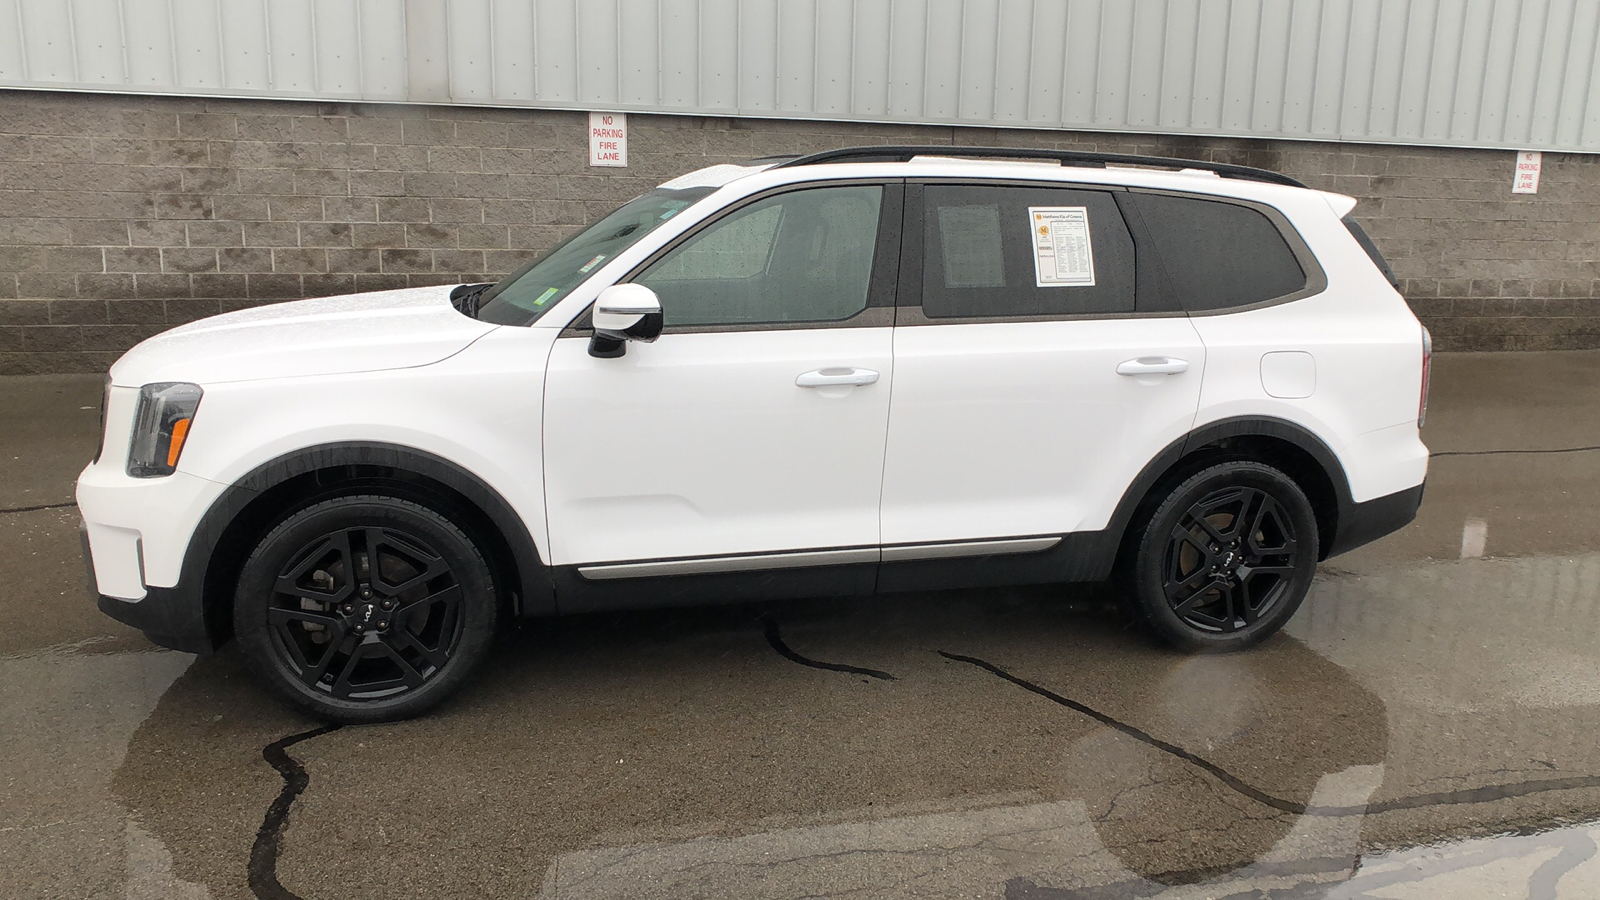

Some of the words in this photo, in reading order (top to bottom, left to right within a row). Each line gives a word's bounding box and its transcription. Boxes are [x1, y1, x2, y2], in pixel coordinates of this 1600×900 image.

[602, 115, 613, 125] NO
[593, 128, 623, 138] PARKING
[597, 152, 620, 160] LANE
